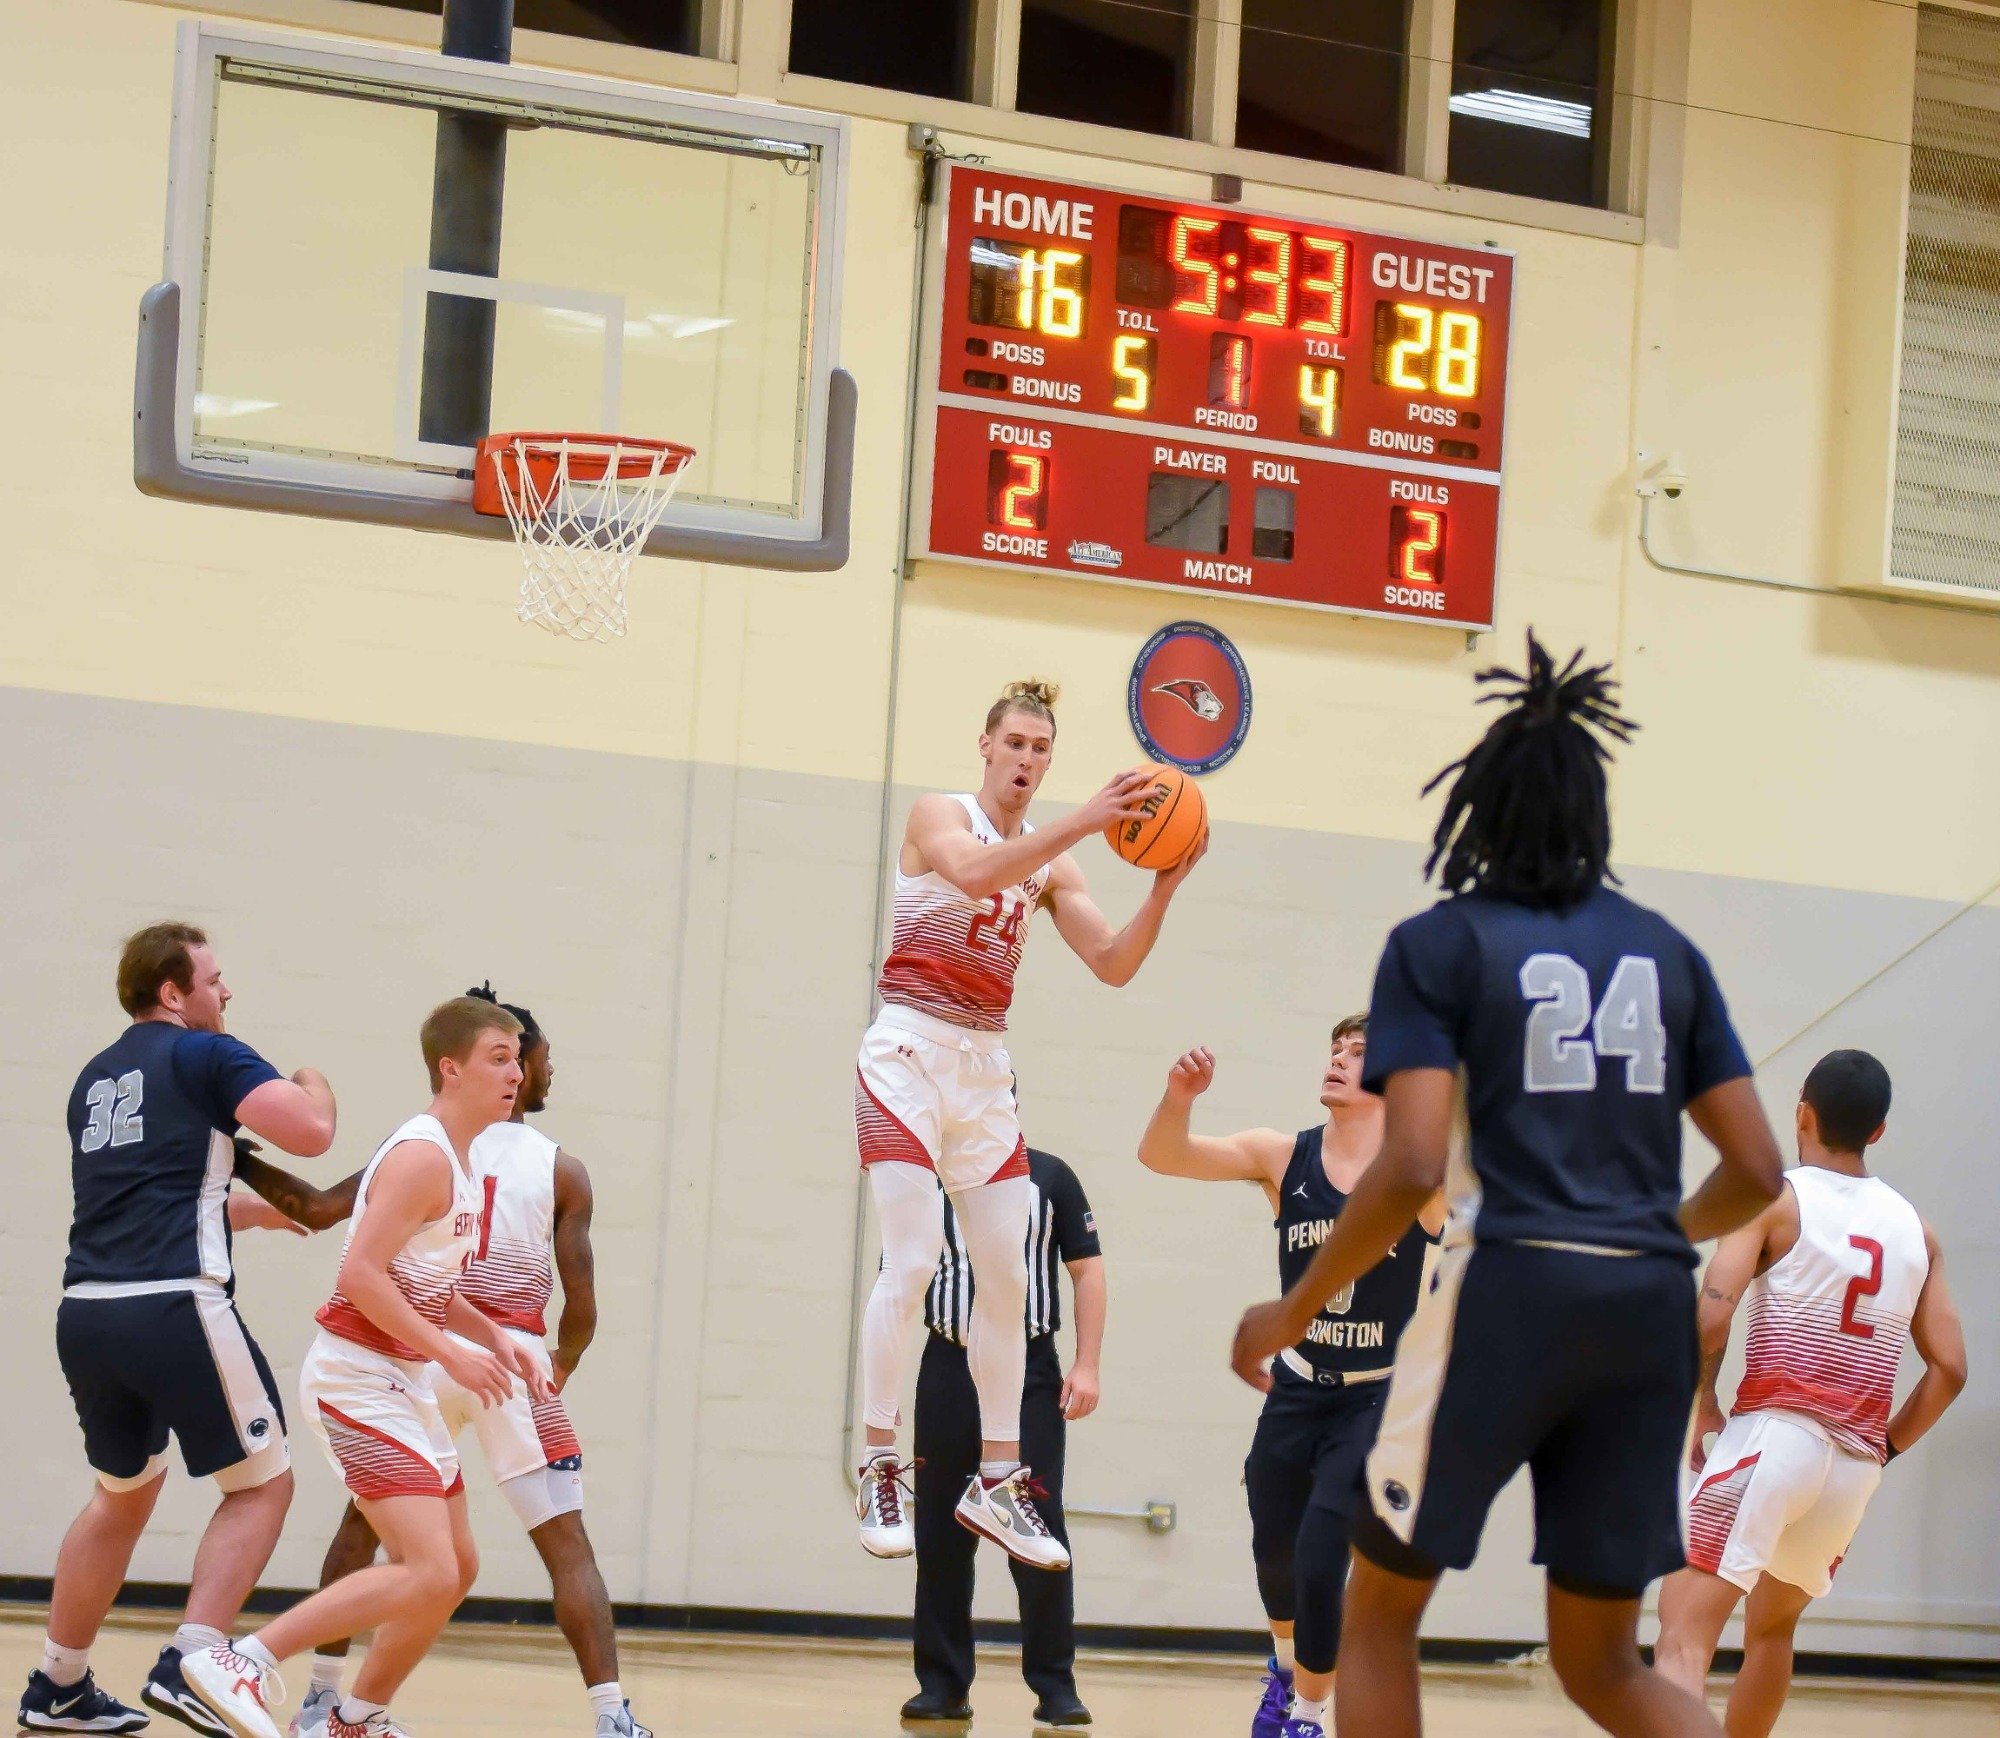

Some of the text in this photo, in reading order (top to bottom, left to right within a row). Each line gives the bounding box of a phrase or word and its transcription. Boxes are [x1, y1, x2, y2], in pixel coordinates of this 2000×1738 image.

[973, 187, 1094, 241] HOME
[1174, 216, 1346, 335] 5:33
[1371, 252, 1494, 304] GUEST
[1015, 249, 1083, 338] 16
[1117, 310, 1159, 333] T.O.L.
[991, 341, 1045, 367] POSS
[1305, 339, 1346, 361] T.O.L.
[1387, 303, 1480, 398] 28
[1012, 376, 1081, 403] BONUS
[1112, 336, 1148, 411] 5
[1230, 340, 1244, 406] 1
[1300, 364, 1336, 436] 4
[1407, 403, 1457, 427] POSS
[989, 423, 1052, 449] FOULS
[1194, 407, 1258, 432] PERIOD
[1368, 428, 1434, 454] BONUS
[1154, 446, 1227, 474] PLAYER
[1252, 461, 1300, 485] FOUL
[1004, 454, 1041, 528] 2
[1390, 480, 1449, 505] FOULS
[982, 532, 1048, 559] SCORE
[1404, 509, 1439, 582] 2
[1184, 559, 1253, 586] MATCH
[1384, 585, 1446, 611] SCORE
[1236, 701, 1250, 741] LEARNING
[964, 891, 1026, 958] 24
[1518, 952, 1667, 1094] 24
[80, 1068, 144, 1154] 32
[1288, 1219, 1336, 1252] PENN
[1837, 1233, 1884, 1341] 2
[1304, 1318, 1384, 1348] BINGTON
